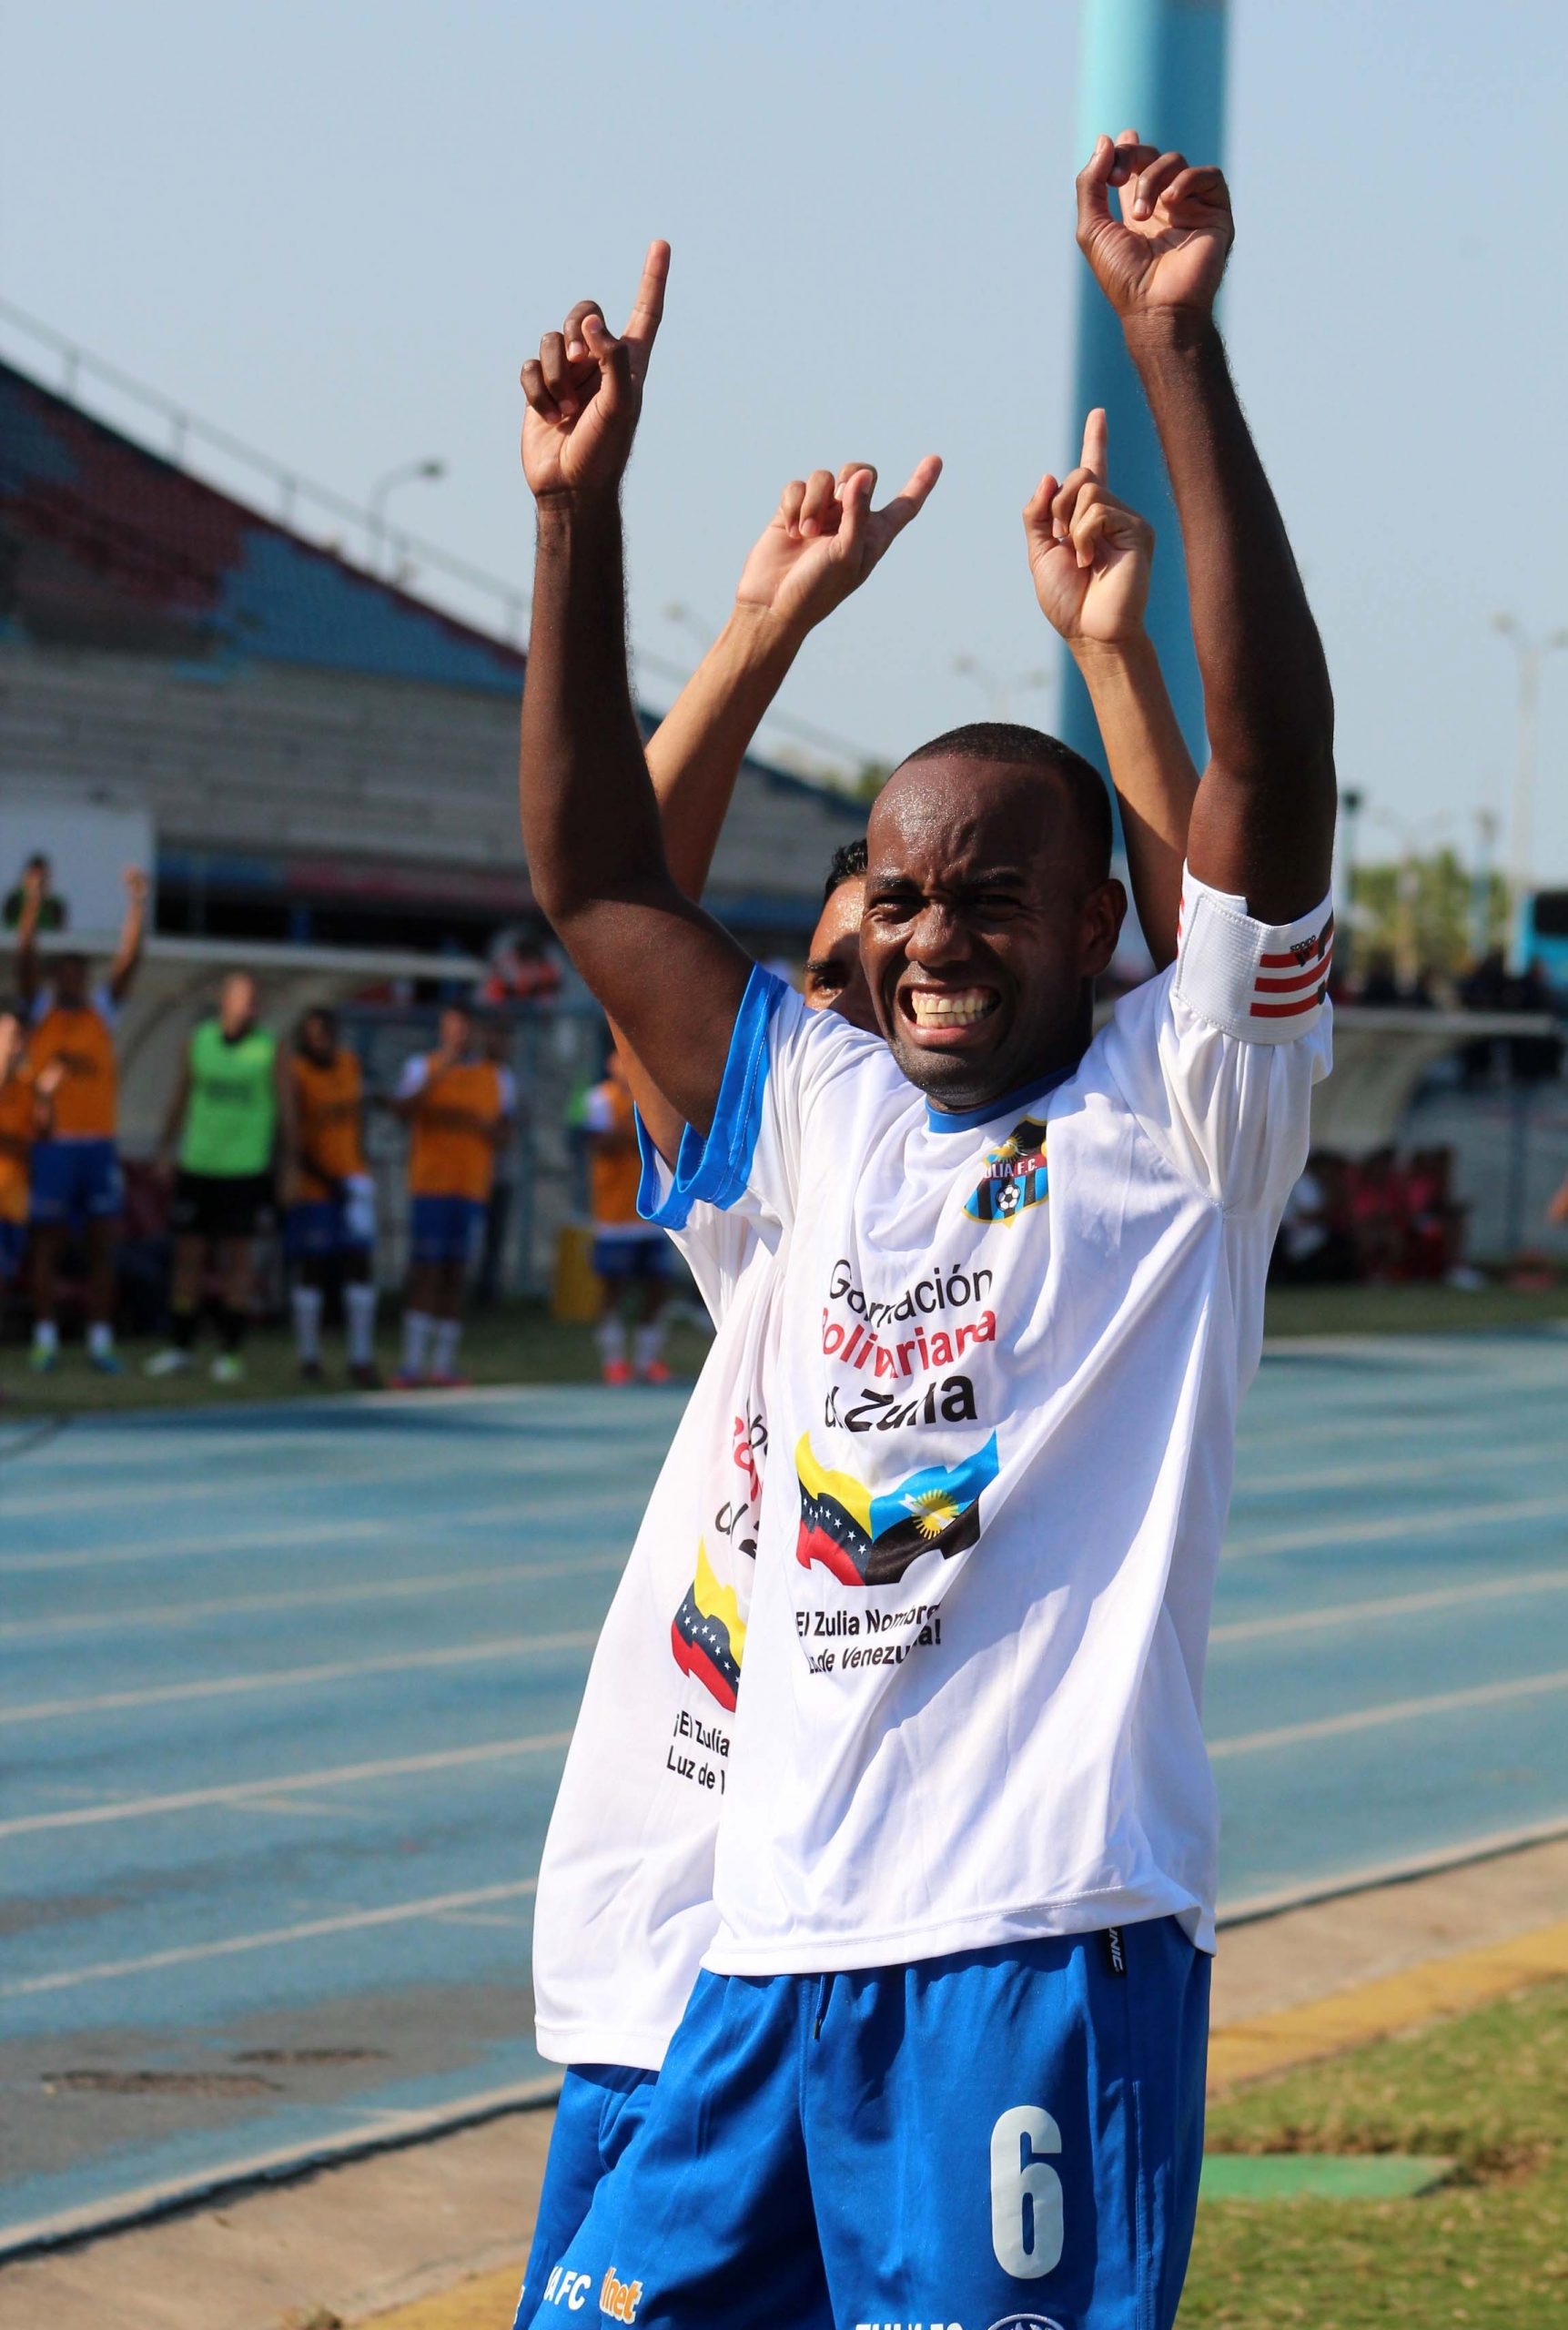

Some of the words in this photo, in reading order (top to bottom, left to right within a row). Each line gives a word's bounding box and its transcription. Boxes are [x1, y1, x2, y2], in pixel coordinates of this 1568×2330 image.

[984, 1163, 1014, 1179] ULIA
[814, 1610, 860, 1636] Zulia
[695, 1719, 730, 1758] Zulia
[666, 1745, 695, 1779] Luz
[698, 1762, 715, 1789] de
[990, 2105, 1064, 2279] 6
